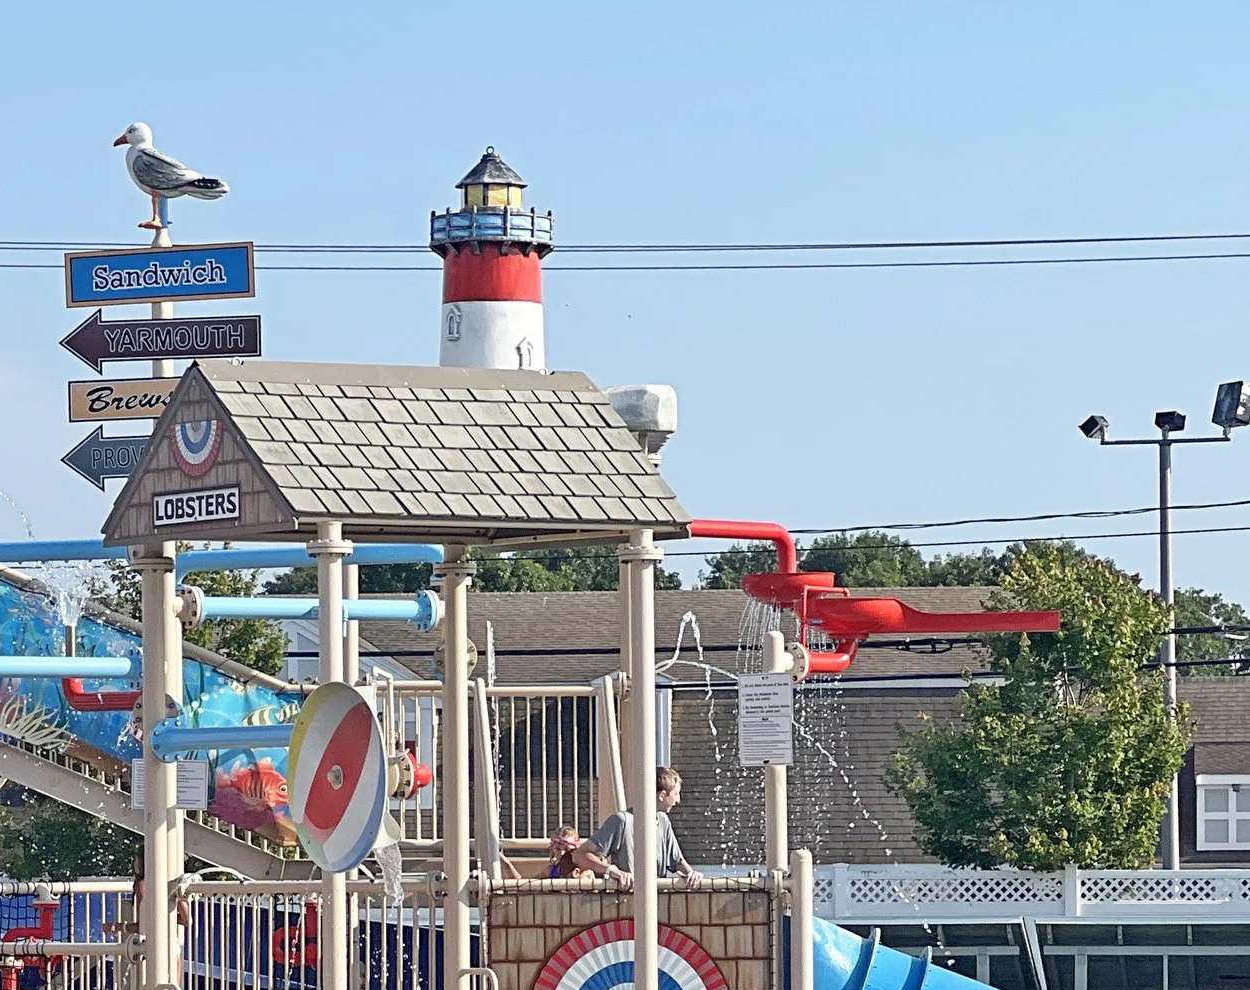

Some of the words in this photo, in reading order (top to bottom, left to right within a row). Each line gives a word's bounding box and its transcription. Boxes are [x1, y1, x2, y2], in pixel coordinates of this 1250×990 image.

[93, 259, 227, 292] Sandwich
[104, 324, 245, 353] YARMOUTH
[155, 492, 237, 521] LOBSTERS
